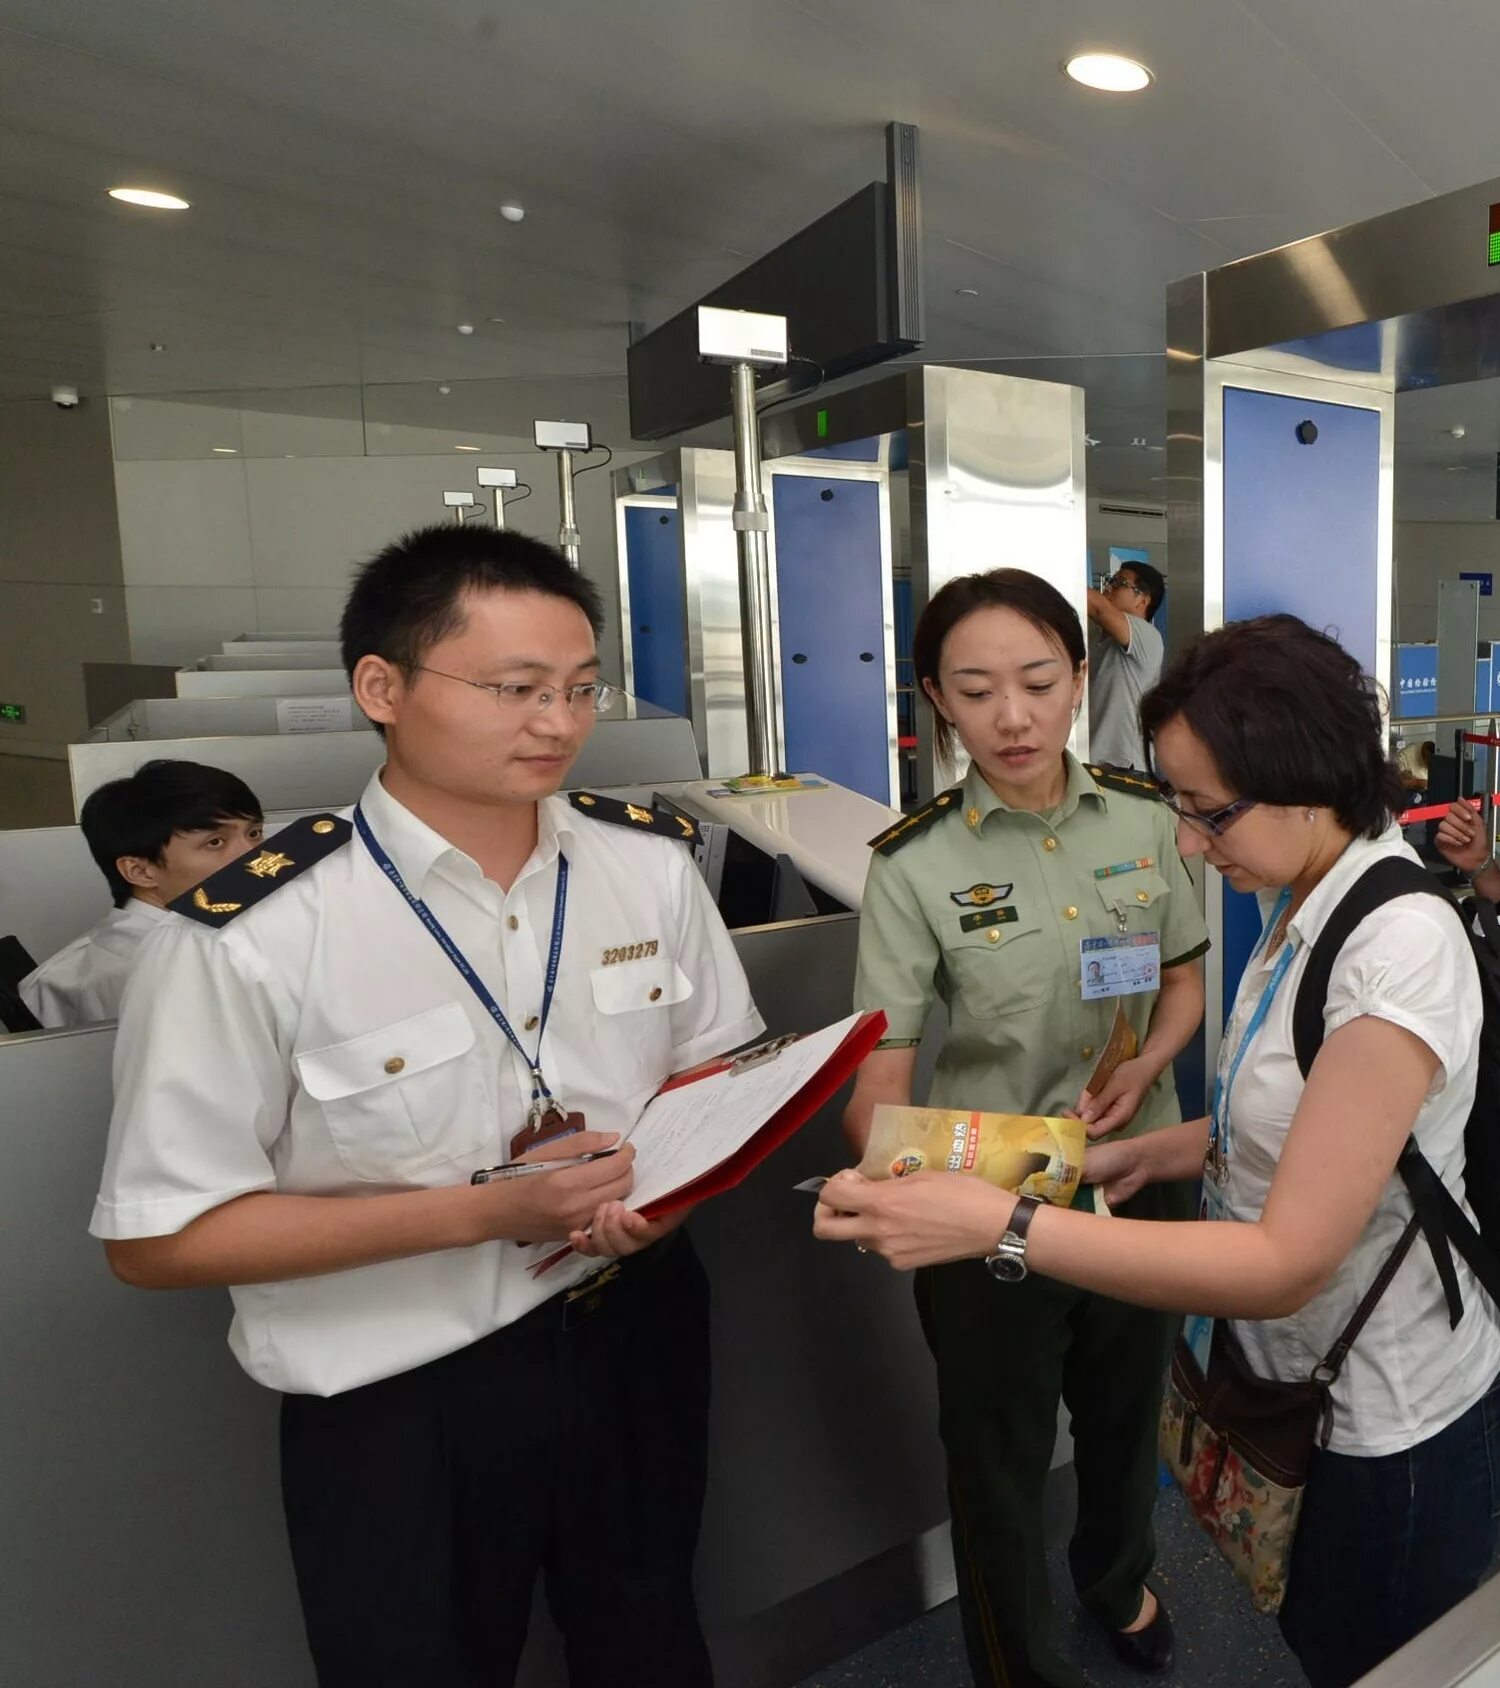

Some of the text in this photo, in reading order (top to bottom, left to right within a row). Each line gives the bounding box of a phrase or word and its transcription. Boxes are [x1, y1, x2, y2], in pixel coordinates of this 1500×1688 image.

[602, 940, 659, 966] 3203279
[947, 1121, 967, 1171] 出血热
